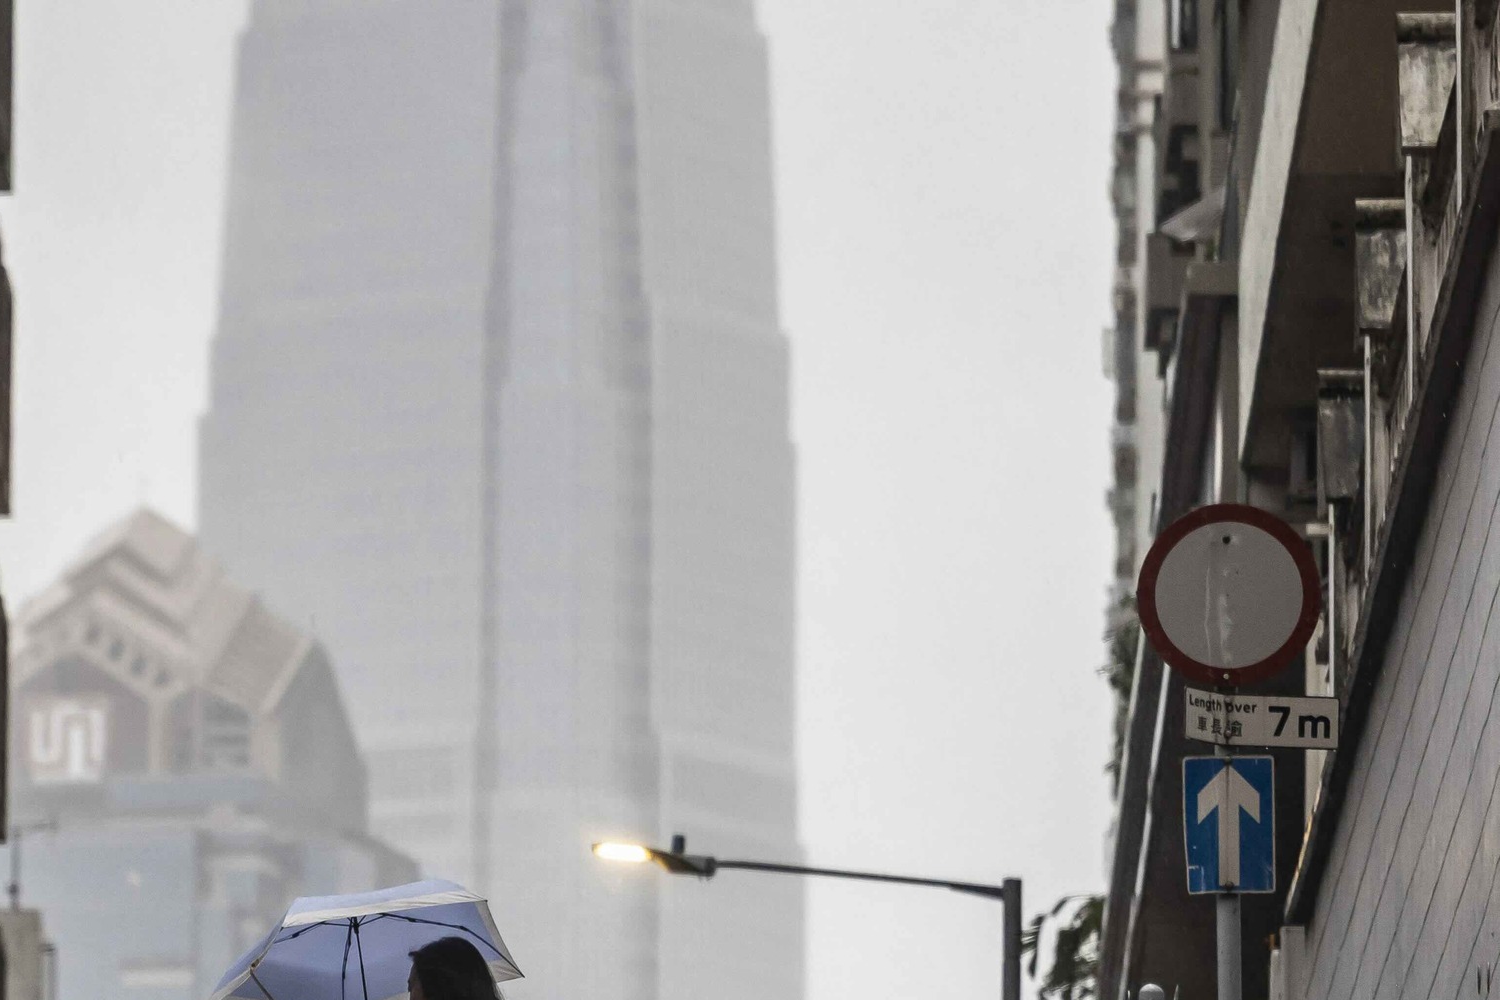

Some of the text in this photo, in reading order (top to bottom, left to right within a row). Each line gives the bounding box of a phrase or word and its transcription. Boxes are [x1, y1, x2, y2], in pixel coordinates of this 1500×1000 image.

[1189, 694, 1330, 738] Length over 7 m
